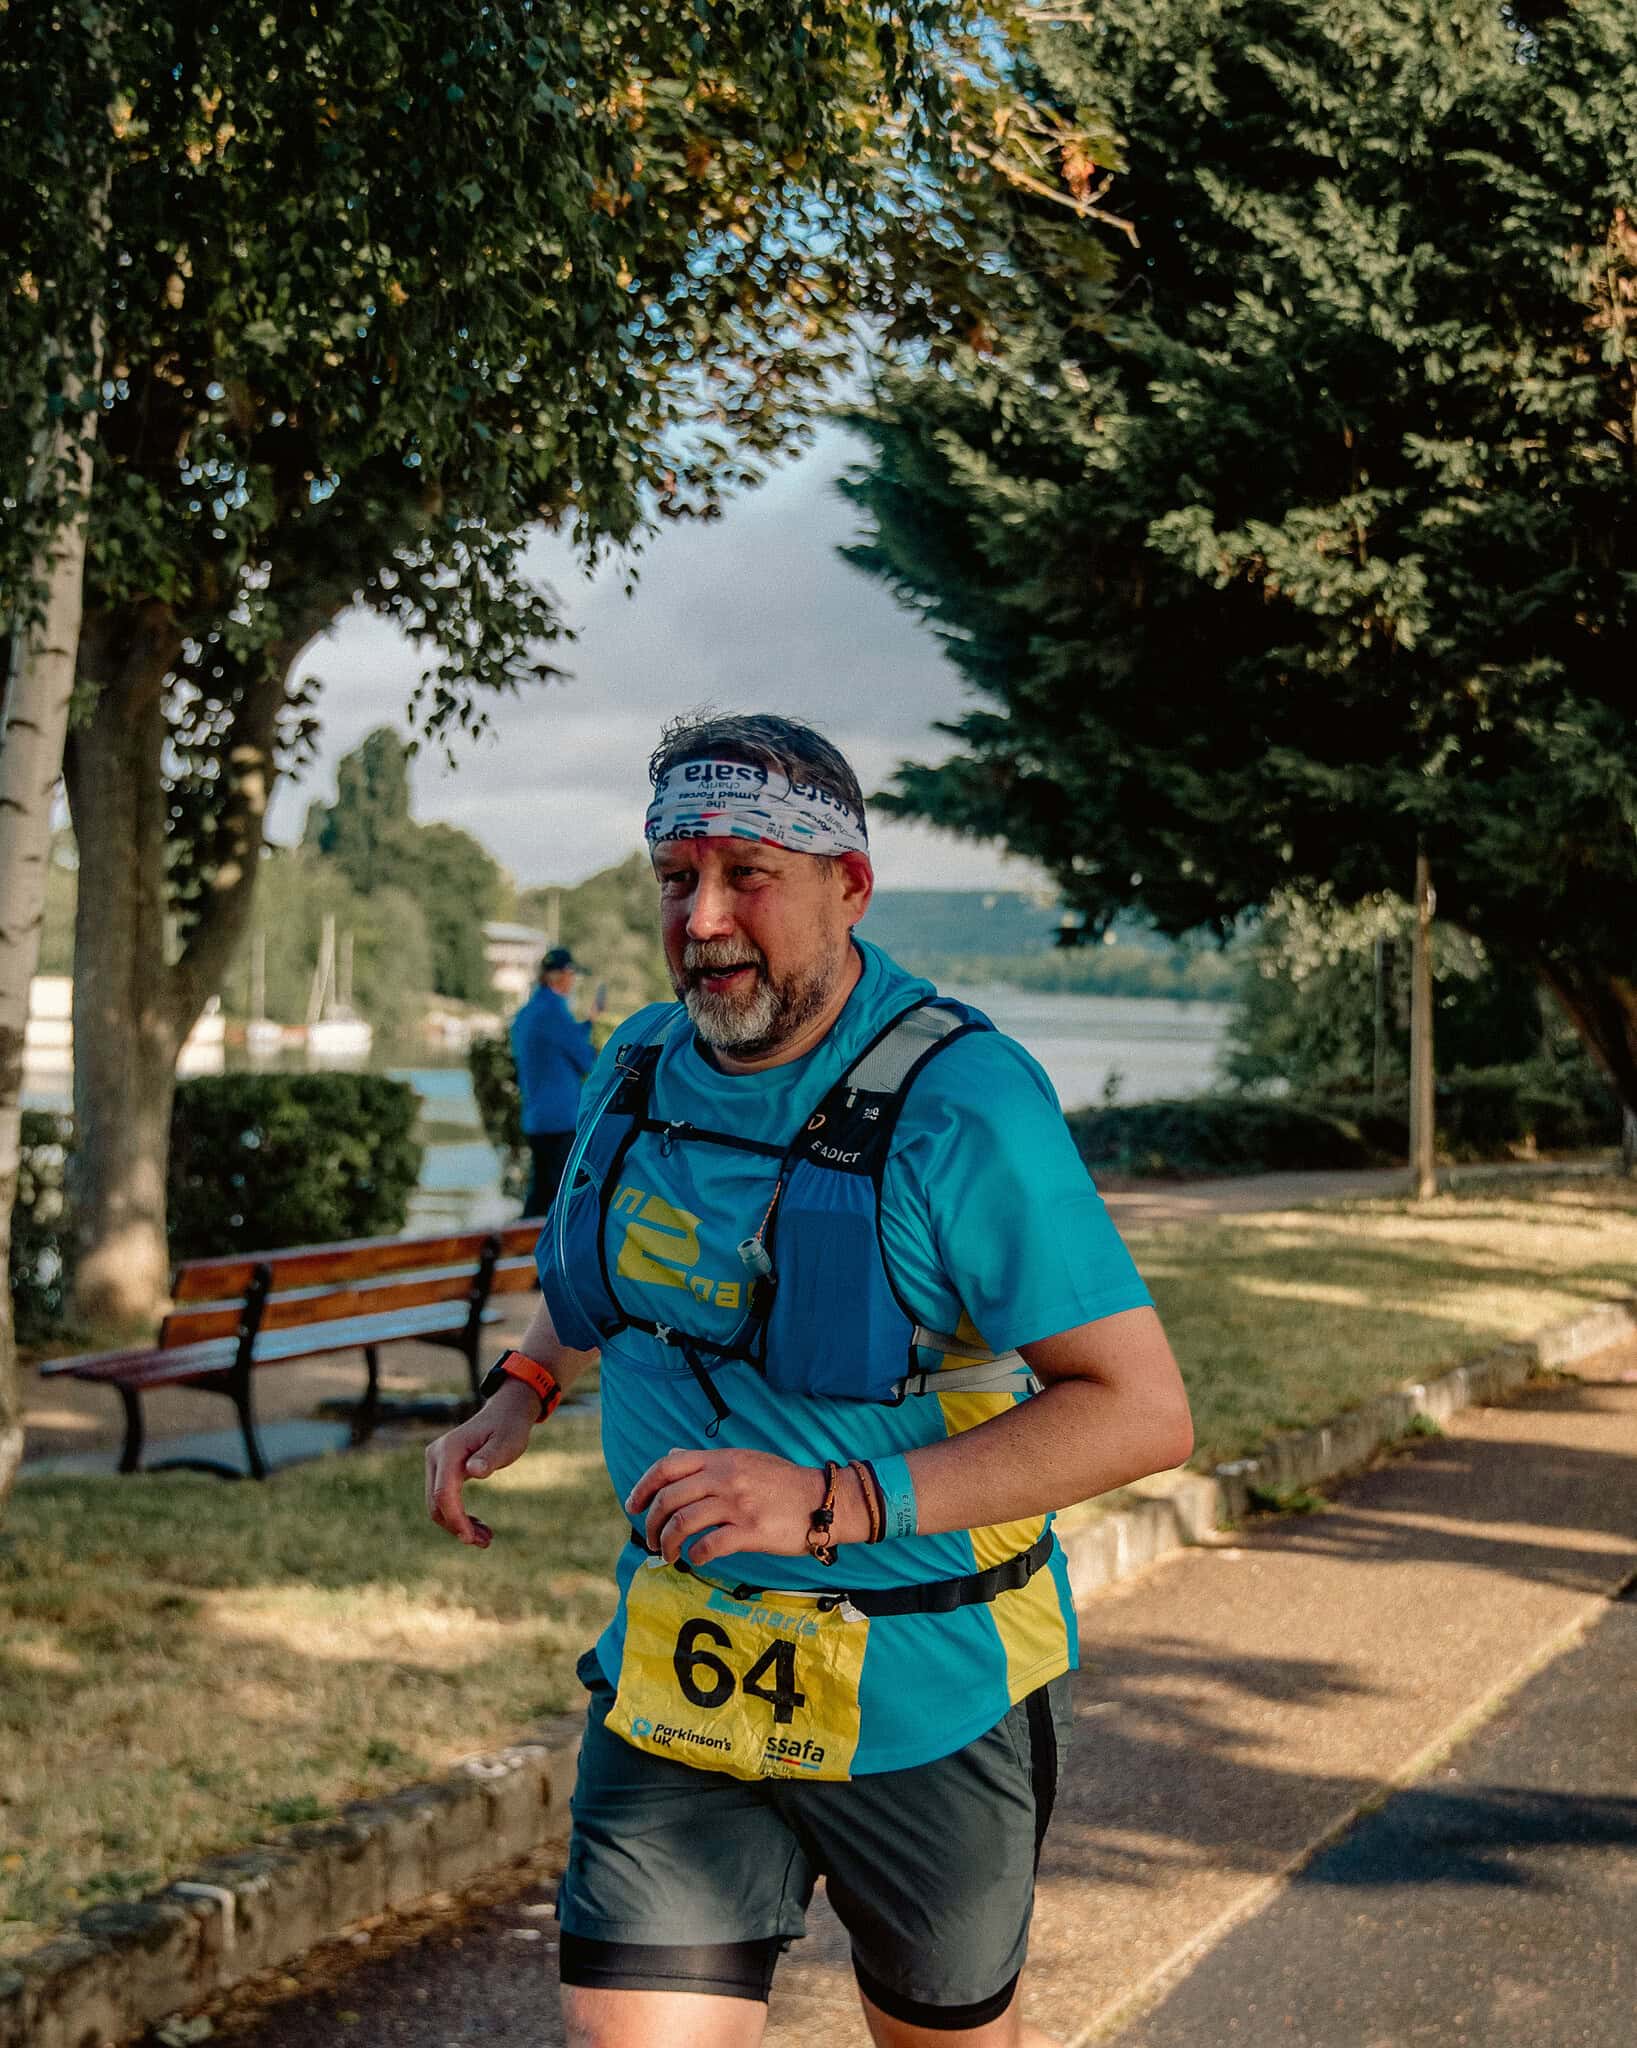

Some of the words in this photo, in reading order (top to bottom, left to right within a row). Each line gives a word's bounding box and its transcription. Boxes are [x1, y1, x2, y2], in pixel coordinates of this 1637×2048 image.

[718, 791, 760, 801] Armed
[810, 1140, 861, 1163] EADICT
[674, 1618, 805, 1724] 64
[652, 1734, 674, 1749] UK
[655, 1724, 732, 1751] Parkinson's
[766, 1736, 825, 1763] ssafa
